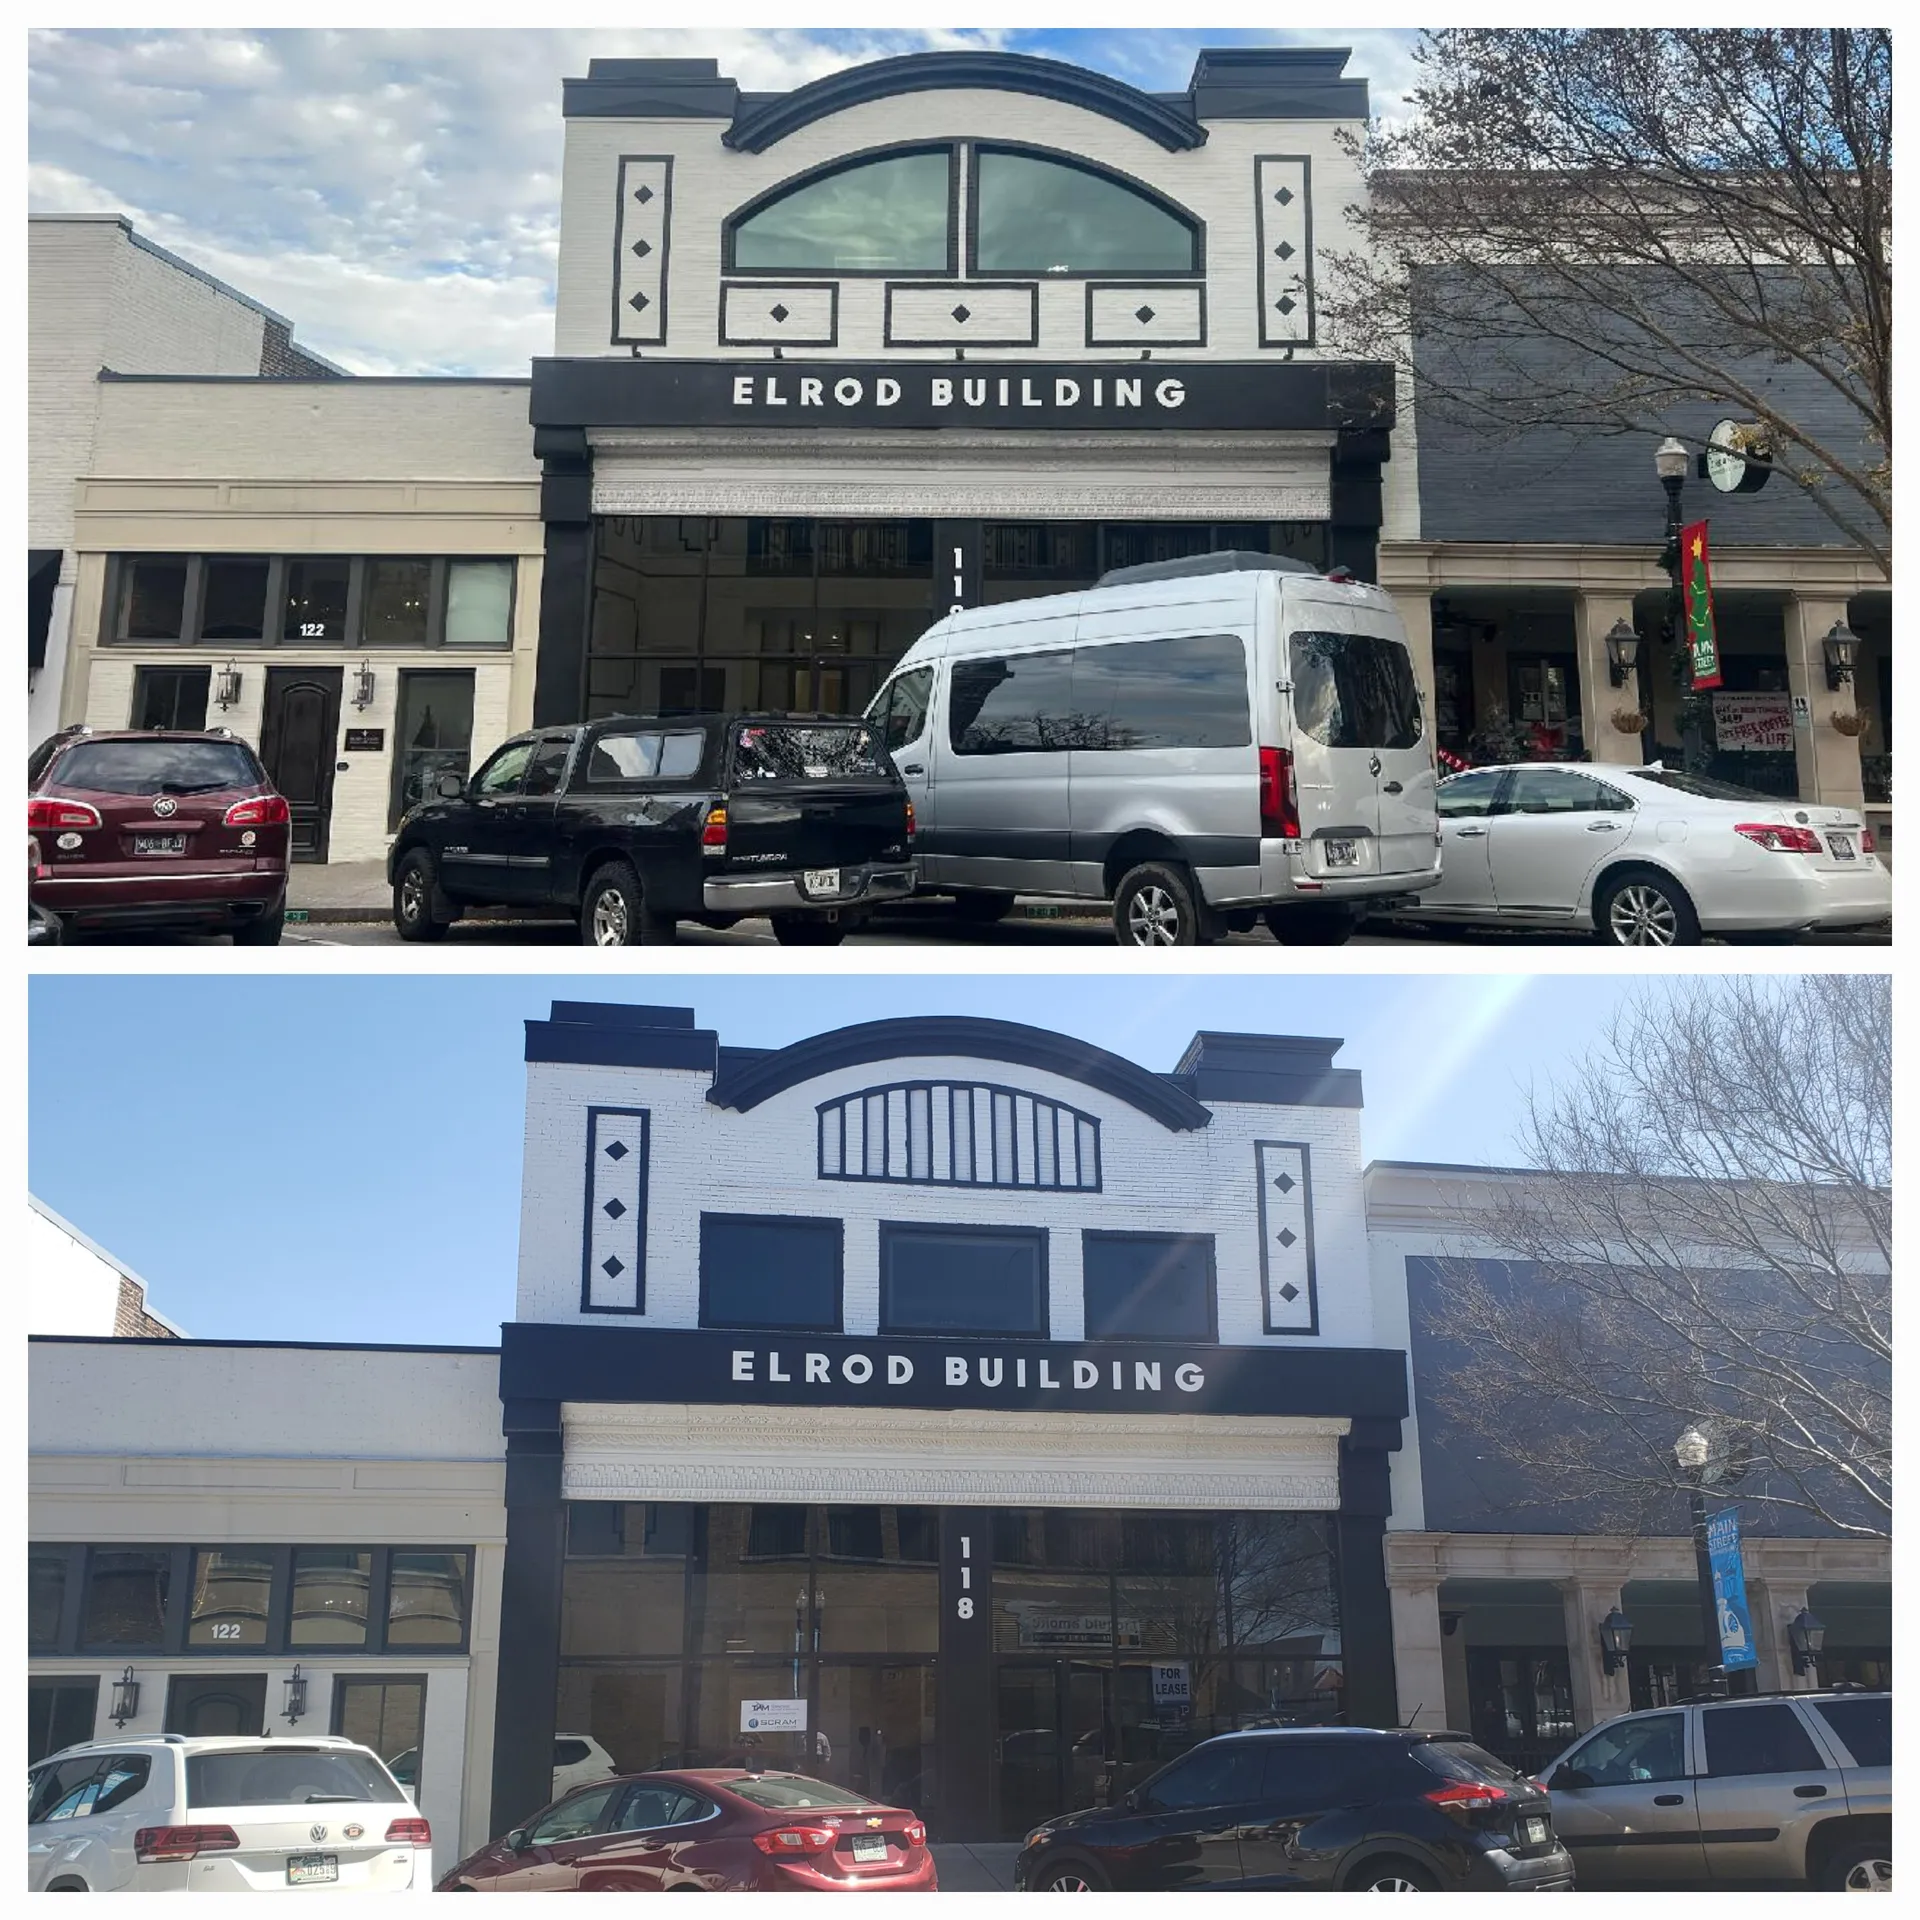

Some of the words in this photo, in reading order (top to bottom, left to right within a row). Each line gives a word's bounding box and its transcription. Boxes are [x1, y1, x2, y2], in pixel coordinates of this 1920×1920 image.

[733, 376, 901, 407] ELROD
[931, 378, 1186, 408] BUILDING
[300, 624, 325, 636] 122
[732, 1350, 914, 1385] ELROD
[945, 1357, 1205, 1392] BUILDING
[211, 1624, 241, 1639] 122
[1160, 1668, 1180, 1679] FOR
[1155, 1684, 1188, 1695] LEASE
